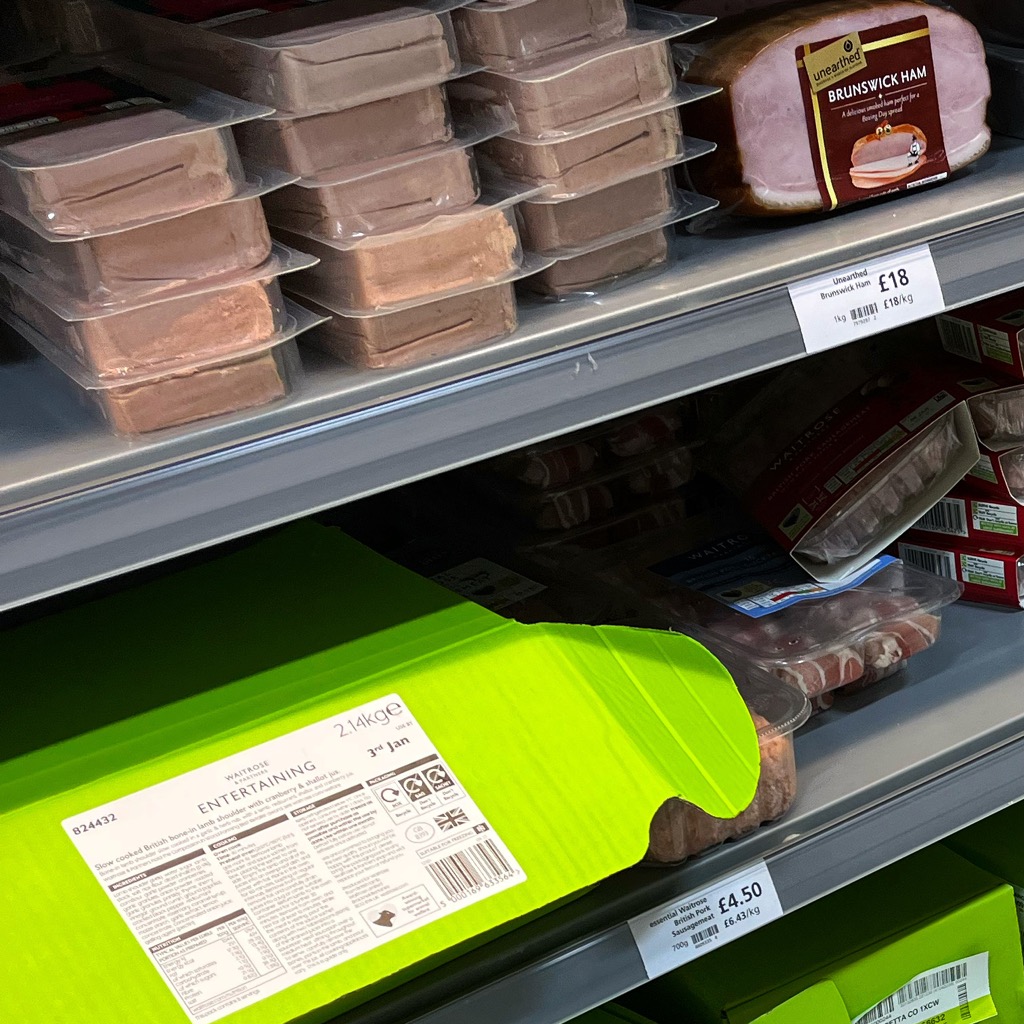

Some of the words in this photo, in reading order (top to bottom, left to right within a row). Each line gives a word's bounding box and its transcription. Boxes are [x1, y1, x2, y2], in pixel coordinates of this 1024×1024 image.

[813, 48, 861, 82] unearthed
[828, 73, 899, 103] BRUNSWICK
[901, 66, 927, 84] HAM
[846, 107, 866, 118] delicious
[866, 102, 884, 113] smoked
[894, 96, 909, 108] perfect
[878, 110, 888, 119] Day
[887, 106, 903, 117] spread
[832, 268, 868, 285] Unearthed
[878, 268, 909, 292] £18
[820, 284, 854, 300] Brunswick
[856, 280, 871, 290] Ham
[834, 314, 846, 323] 1kg
[884, 294, 914, 310] £18/kg
[367, 744, 384, 758] 3rd
[387, 737, 410, 752] Jan
[224, 760, 270, 781] WAITROSE
[197, 760, 316, 814] ENTERTAINING
[72, 813, 118, 836] 824432
[94, 859, 114, 871] Slow
[116, 847, 143, 863] cooked
[143, 837, 168, 851] British
[168, 827, 196, 841] bone-in
[197, 819, 215, 832] lamb
[217, 805, 246, 823] shoulder
[248, 799, 264, 809] with
[265, 785, 298, 804] cranberry
[306, 774, 328, 785] shallot
[718, 882, 762, 915] £4.50
[649, 910, 678, 928] essential
[678, 897, 708, 915] Waitrose
[674, 912, 695, 926] British
[696, 905, 711, 916] Pork
[671, 913, 715, 938] Sausagemeat
[672, 941, 689, 952] 700g
[724, 905, 760, 929] £6.43/kg
[907, 1008, 918, 1018] CO
